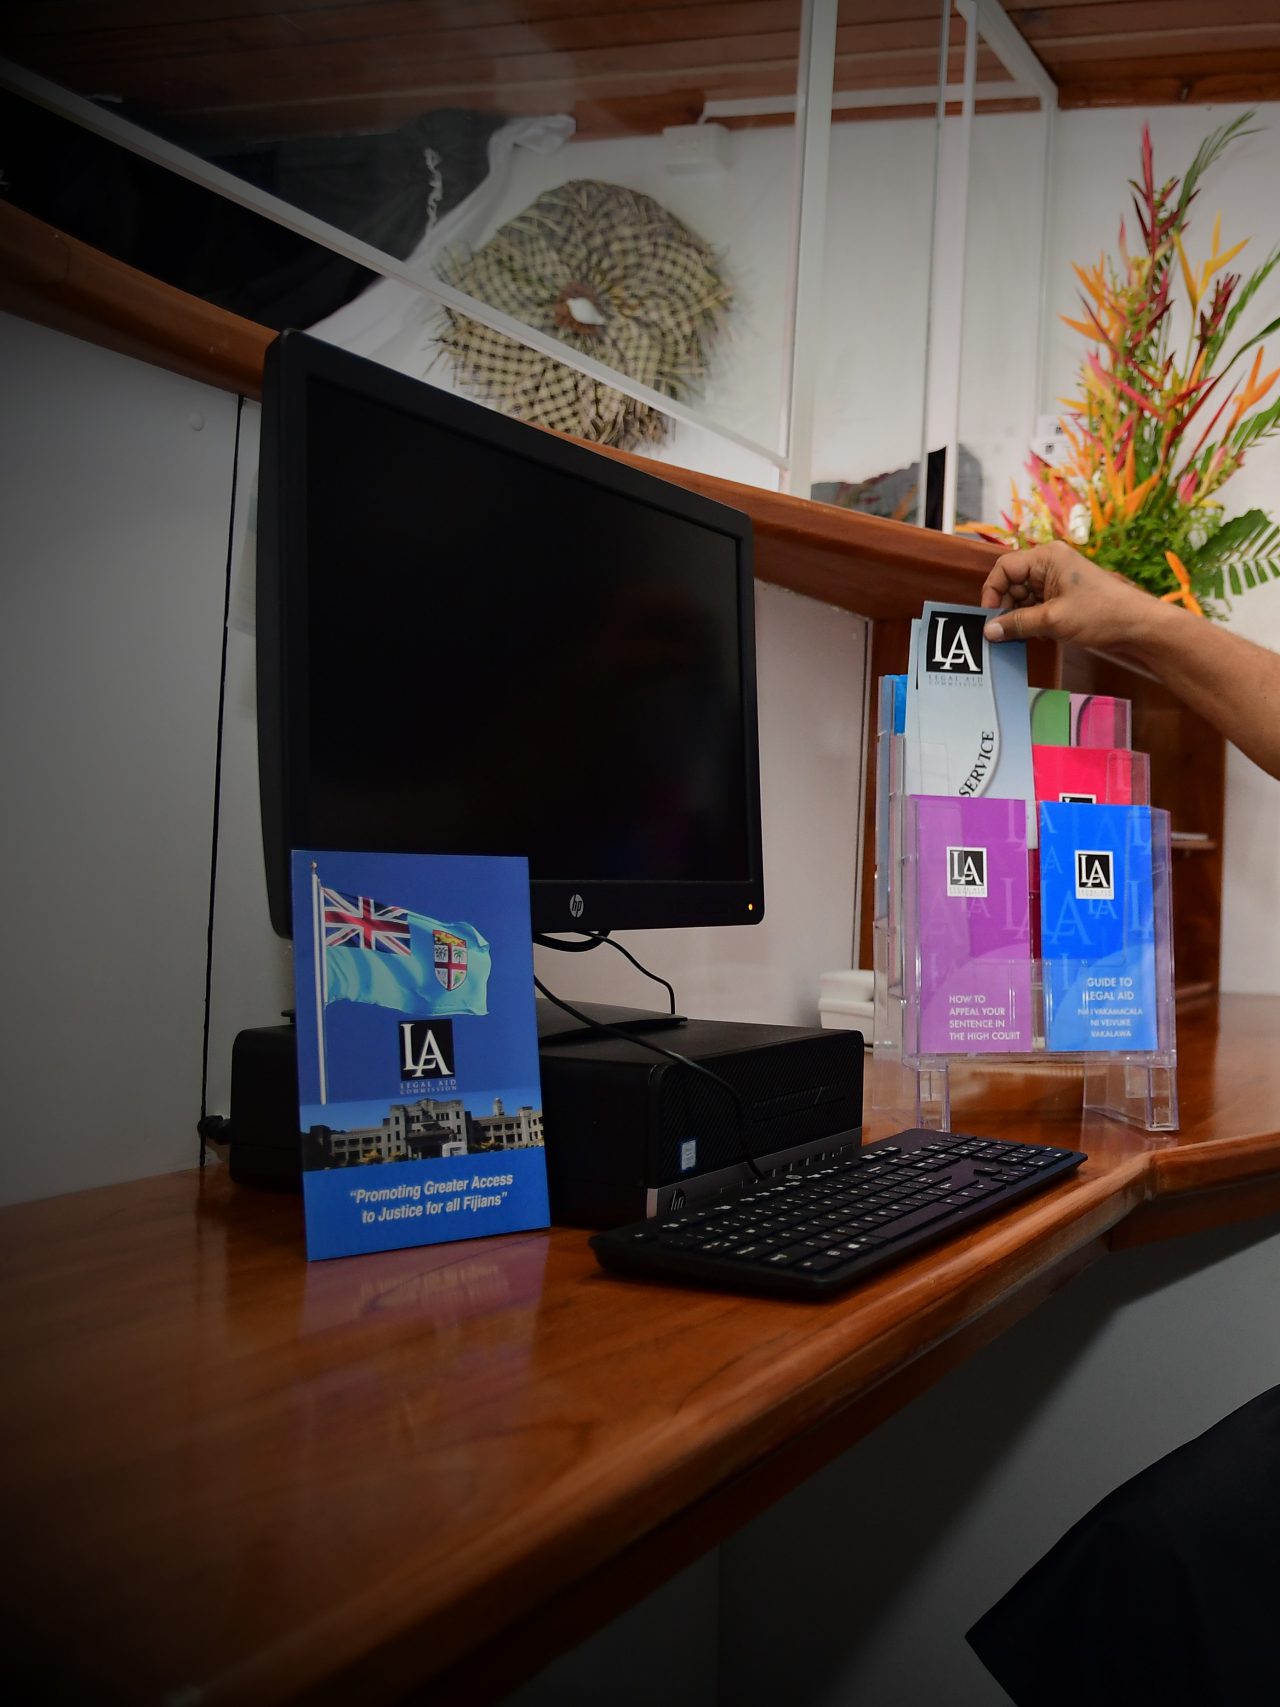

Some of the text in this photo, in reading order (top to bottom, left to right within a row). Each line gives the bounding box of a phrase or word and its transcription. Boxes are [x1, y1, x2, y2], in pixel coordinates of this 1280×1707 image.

[932, 616, 981, 672] LA
[958, 730, 995, 797] SERVICE
[951, 851, 983, 885] LA
[1080, 855, 1109, 888] LA
[1087, 977, 1133, 988] GUIDE TO
[948, 995, 986, 1004] HOW TO
[1087, 991, 1135, 1001] LEGAL AID
[949, 1008, 1005, 1016] APPEAL YOUR
[949, 1020, 1005, 1028] SENTENCE IN
[949, 1032, 965, 1041] THE
[967, 1032, 990, 1041] HIGH
[400, 1022, 453, 1078] LA
[400, 1081, 432, 1090] LEGAL
[424, 1178, 469, 1196] Greater
[471, 1173, 513, 1190] Access
[361, 1209, 376, 1224] to
[377, 1204, 423, 1222] Justice
[425, 1200, 444, 1216] for
[445, 1197, 460, 1213] all
